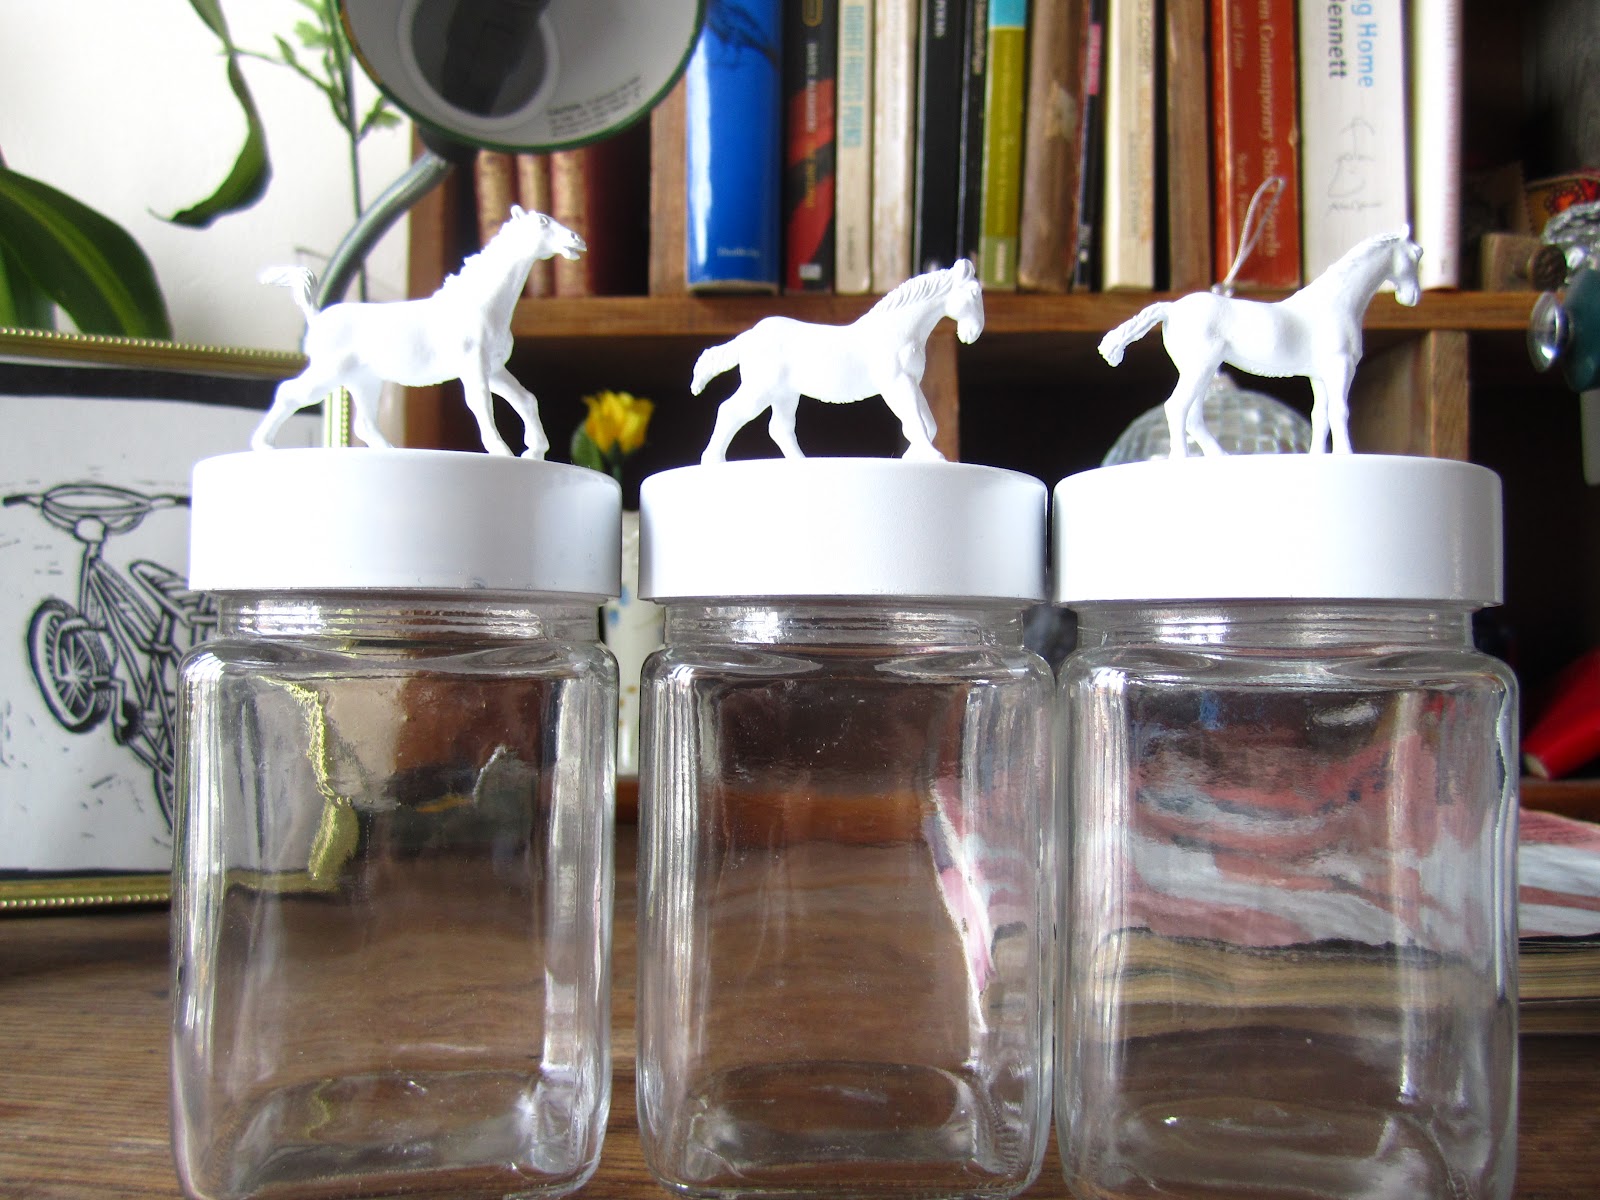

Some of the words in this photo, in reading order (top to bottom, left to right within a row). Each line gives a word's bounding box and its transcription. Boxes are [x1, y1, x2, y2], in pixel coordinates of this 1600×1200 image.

[1351, 0, 1374, 17] g
[1258, 24, 1275, 142] Contemporary
[1357, 23, 1378, 88] Home
